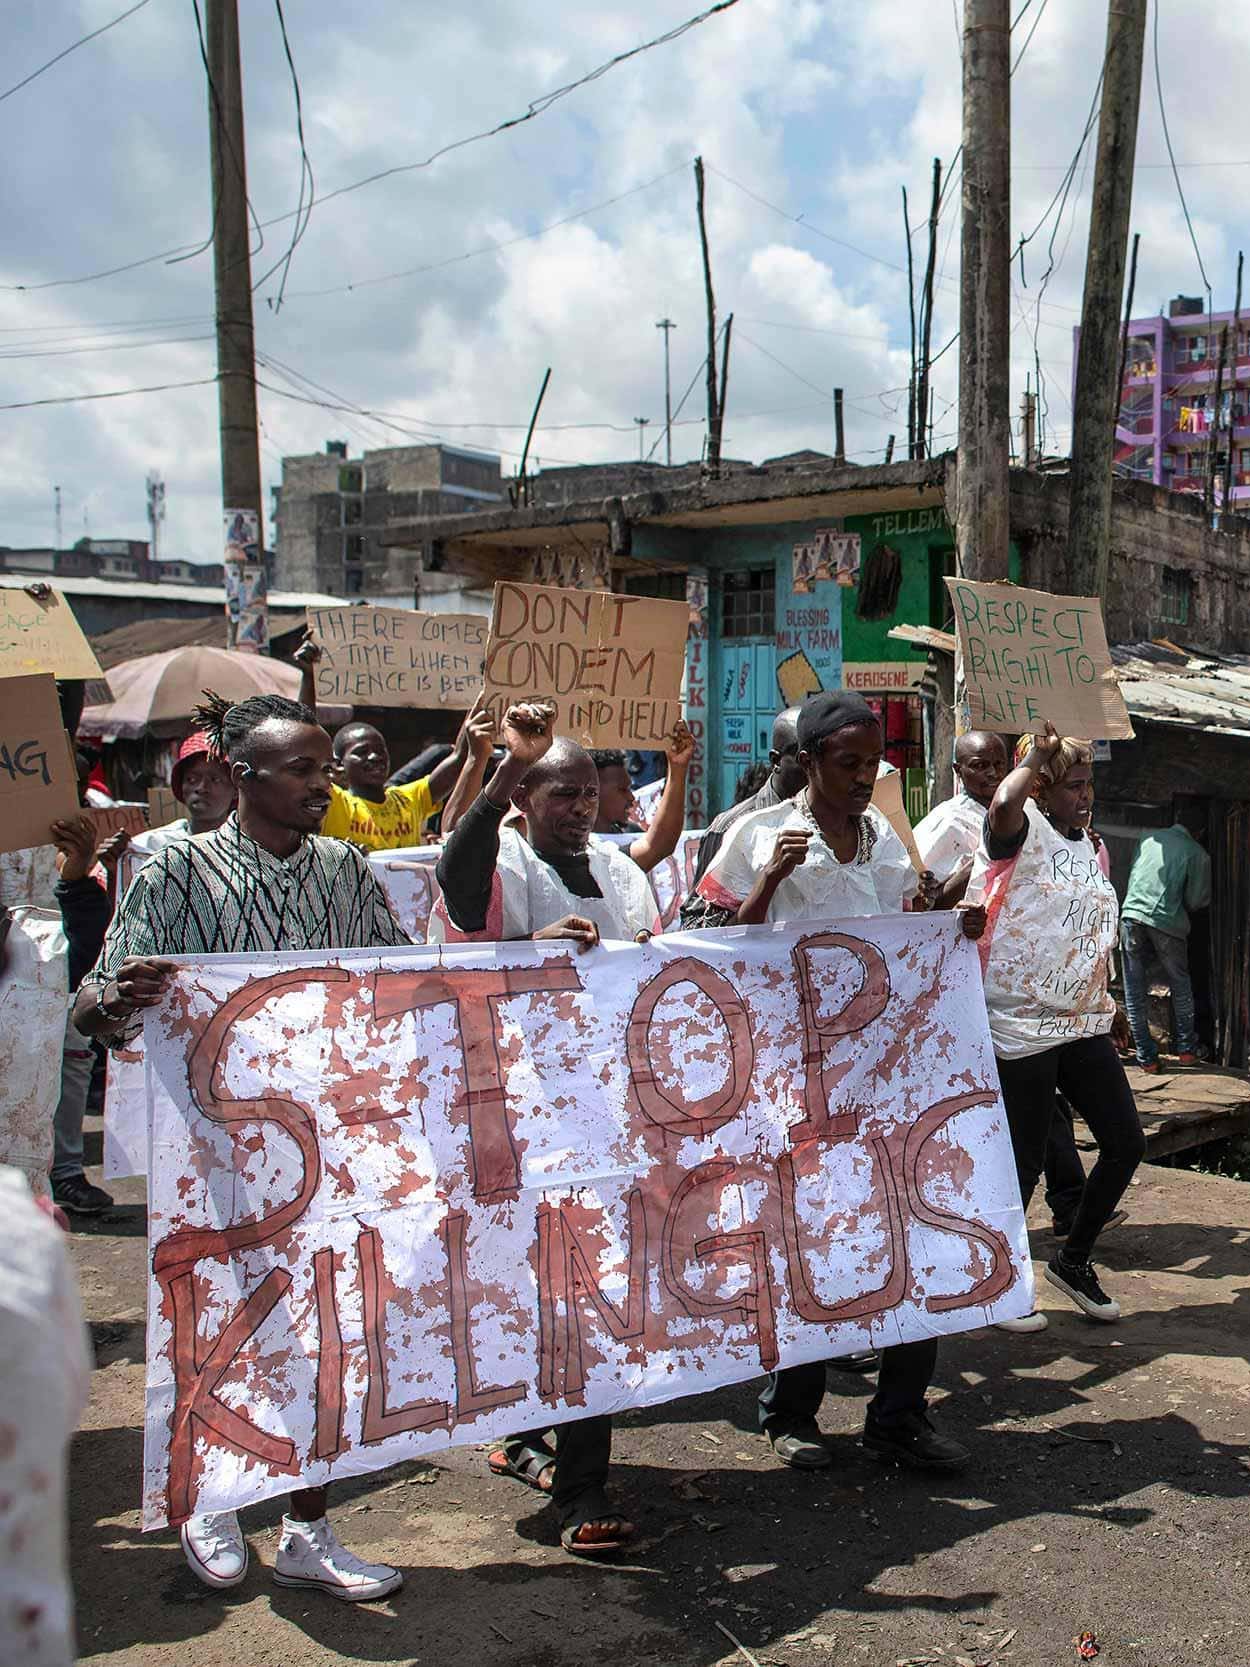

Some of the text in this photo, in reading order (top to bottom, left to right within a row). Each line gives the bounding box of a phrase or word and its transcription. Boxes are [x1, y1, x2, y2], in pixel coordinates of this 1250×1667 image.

[316, 610, 489, 645] THERE COMES
[956, 585, 1095, 647] RESPECT
[776, 628, 840, 650] MILK FARM
[319, 643, 470, 673] A TIME WHEN
[487, 639, 656, 697] CONDEM
[969, 636, 1096, 689] RIGHT TO
[318, 667, 486, 698] SILENCE IS BETT
[846, 671, 909, 688] KEROSENE
[569, 699, 614, 731] INTO
[618, 699, 674, 742] HELL
[978, 684, 1042, 723] LIFE
[1062, 898, 1113, 934] RIGH
[1071, 935, 1098, 960] TO
[1040, 969, 1089, 1001] LIVE
[1037, 1010, 1112, 1037] BULLE
[153, 931, 891, 1275] STOP
[163, 1089, 1014, 1526] KILLING US
